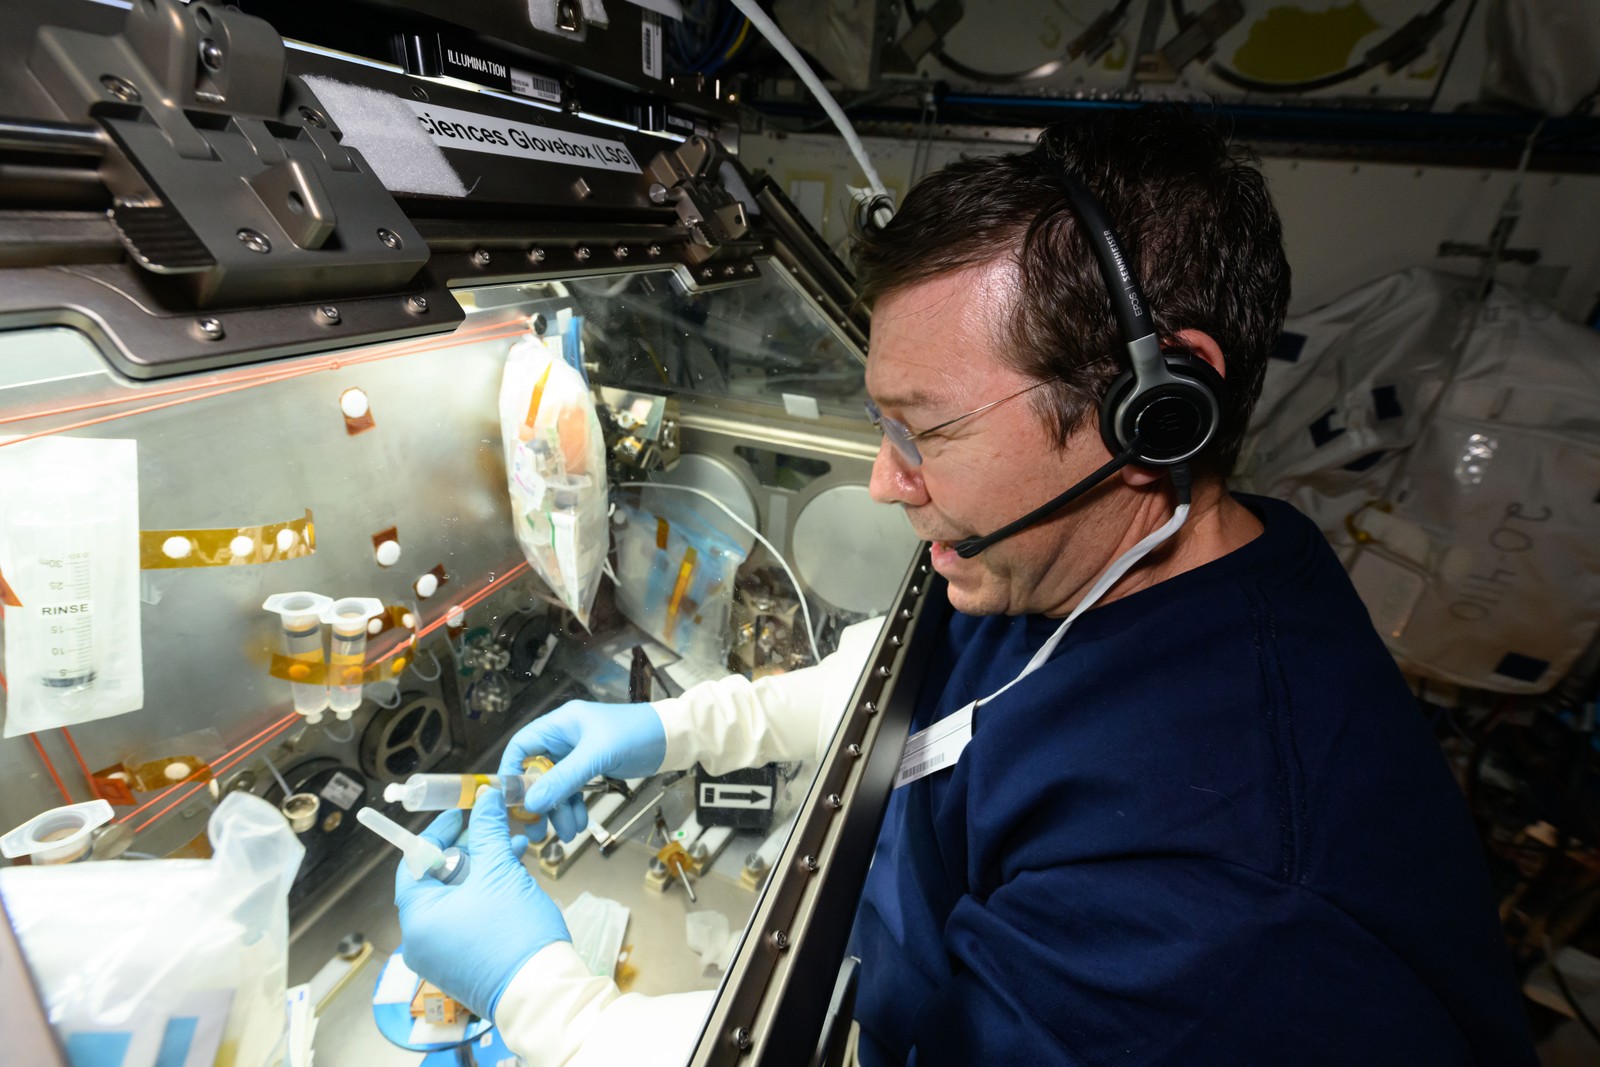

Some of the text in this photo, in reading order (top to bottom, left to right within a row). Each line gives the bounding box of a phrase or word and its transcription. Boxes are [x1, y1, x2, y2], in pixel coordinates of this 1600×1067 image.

[447, 49, 507, 78] ILLUMINATION
[508, 128, 596, 158] Glovebox
[592, 143, 638, 170] (LSG)
[1103, 229, 1143, 317] EPOS SENNHEISER
[42, 603, 89, 615] RINSE
